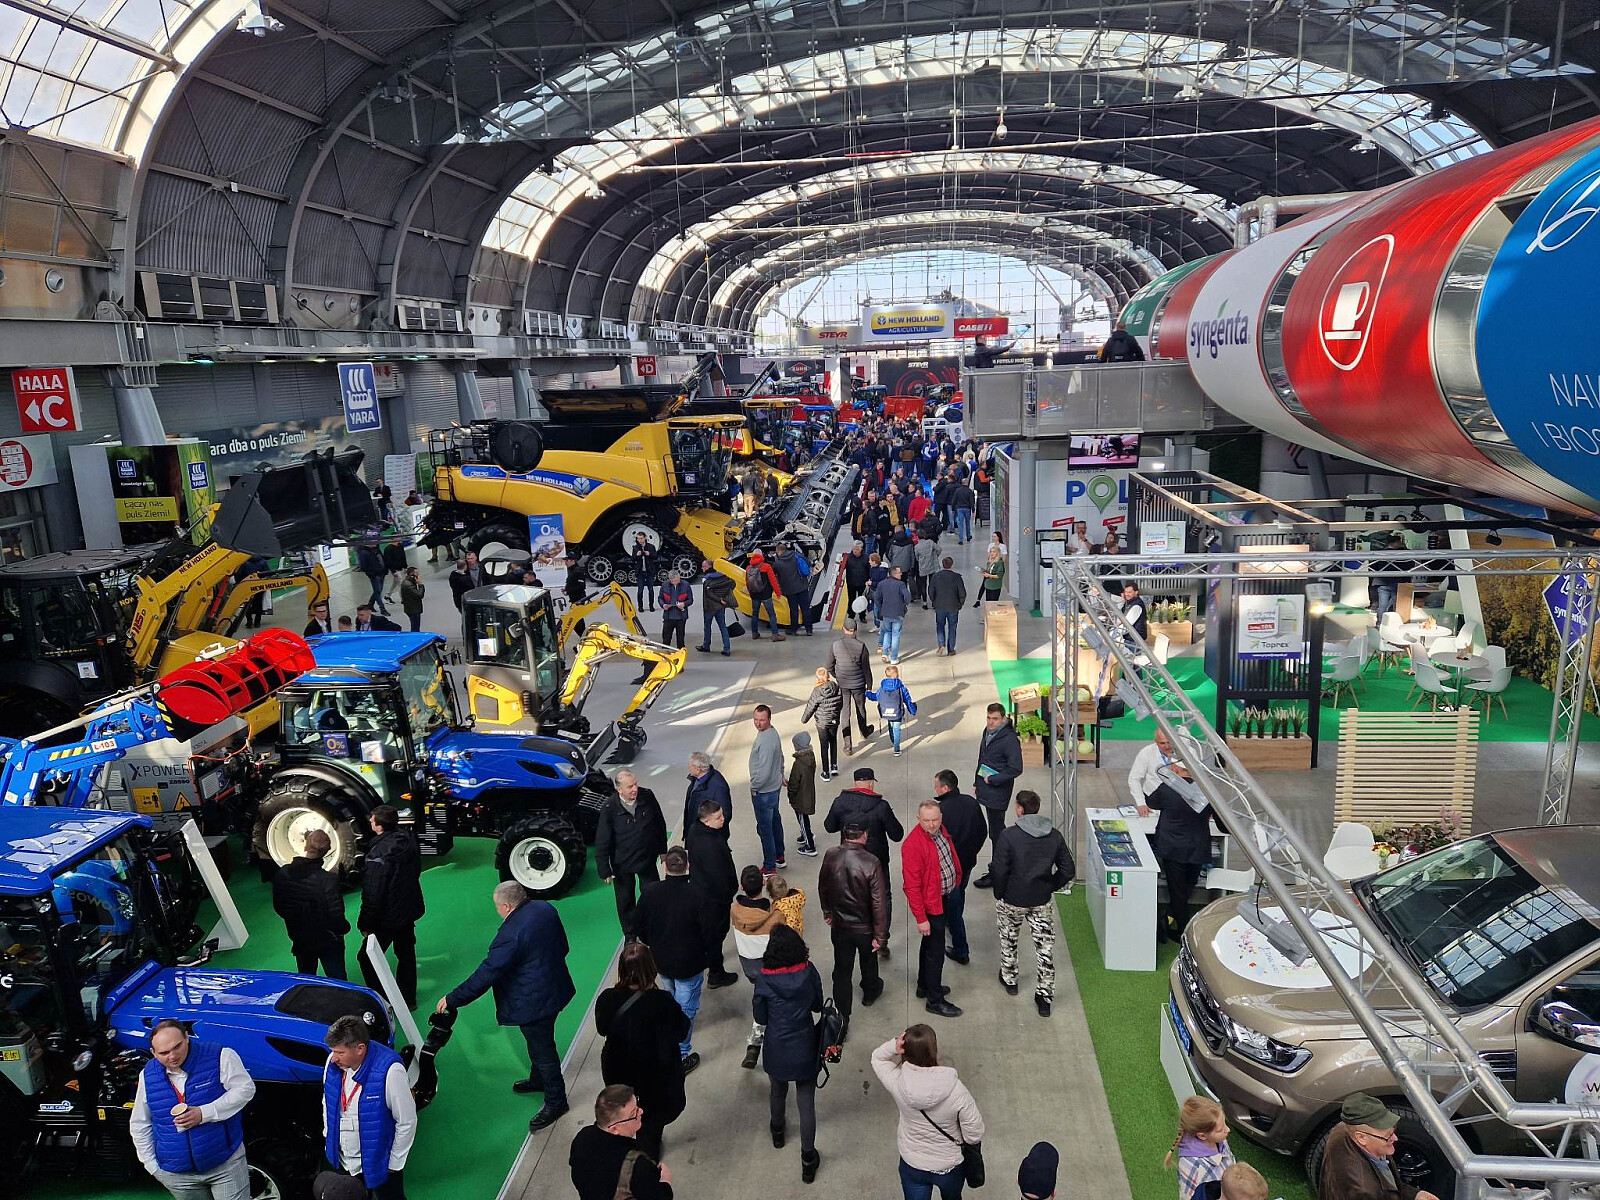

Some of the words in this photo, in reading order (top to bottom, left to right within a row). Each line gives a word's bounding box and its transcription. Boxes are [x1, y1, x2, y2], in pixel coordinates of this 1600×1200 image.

[906, 315, 940, 323] HOLLAND
[819, 331, 848, 339] STEYR
[1191, 309, 1249, 359] syngenta
[645, 363, 654, 374] D
[908, 361, 929, 369] STEYR
[19, 374, 64, 391] HALA
[41, 395, 69, 428] C
[349, 411, 376, 425] YARA
[210, 443, 227, 456] ara
[229, 438, 248, 453] dba
[249, 441, 257, 450] o
[258, 436, 279, 451] puls
[280, 430, 308, 446] Ziemi!
[525, 475, 543, 483] NEW
[543, 477, 574, 490] HOLLAND
[541, 525, 560, 536] 0%
[178, 562, 193, 575] NEW
[191, 545, 218, 566] HOLLAND
[250, 584, 265, 592] NEW
[265, 580, 294, 590] HOLLAND
[1261, 641, 1290, 649] Toprex
[93, 741, 115, 751] L-103
[326, 738, 346, 750] 0%
[1110, 872, 1119, 884] 3
[1110, 886, 1119, 897] E
